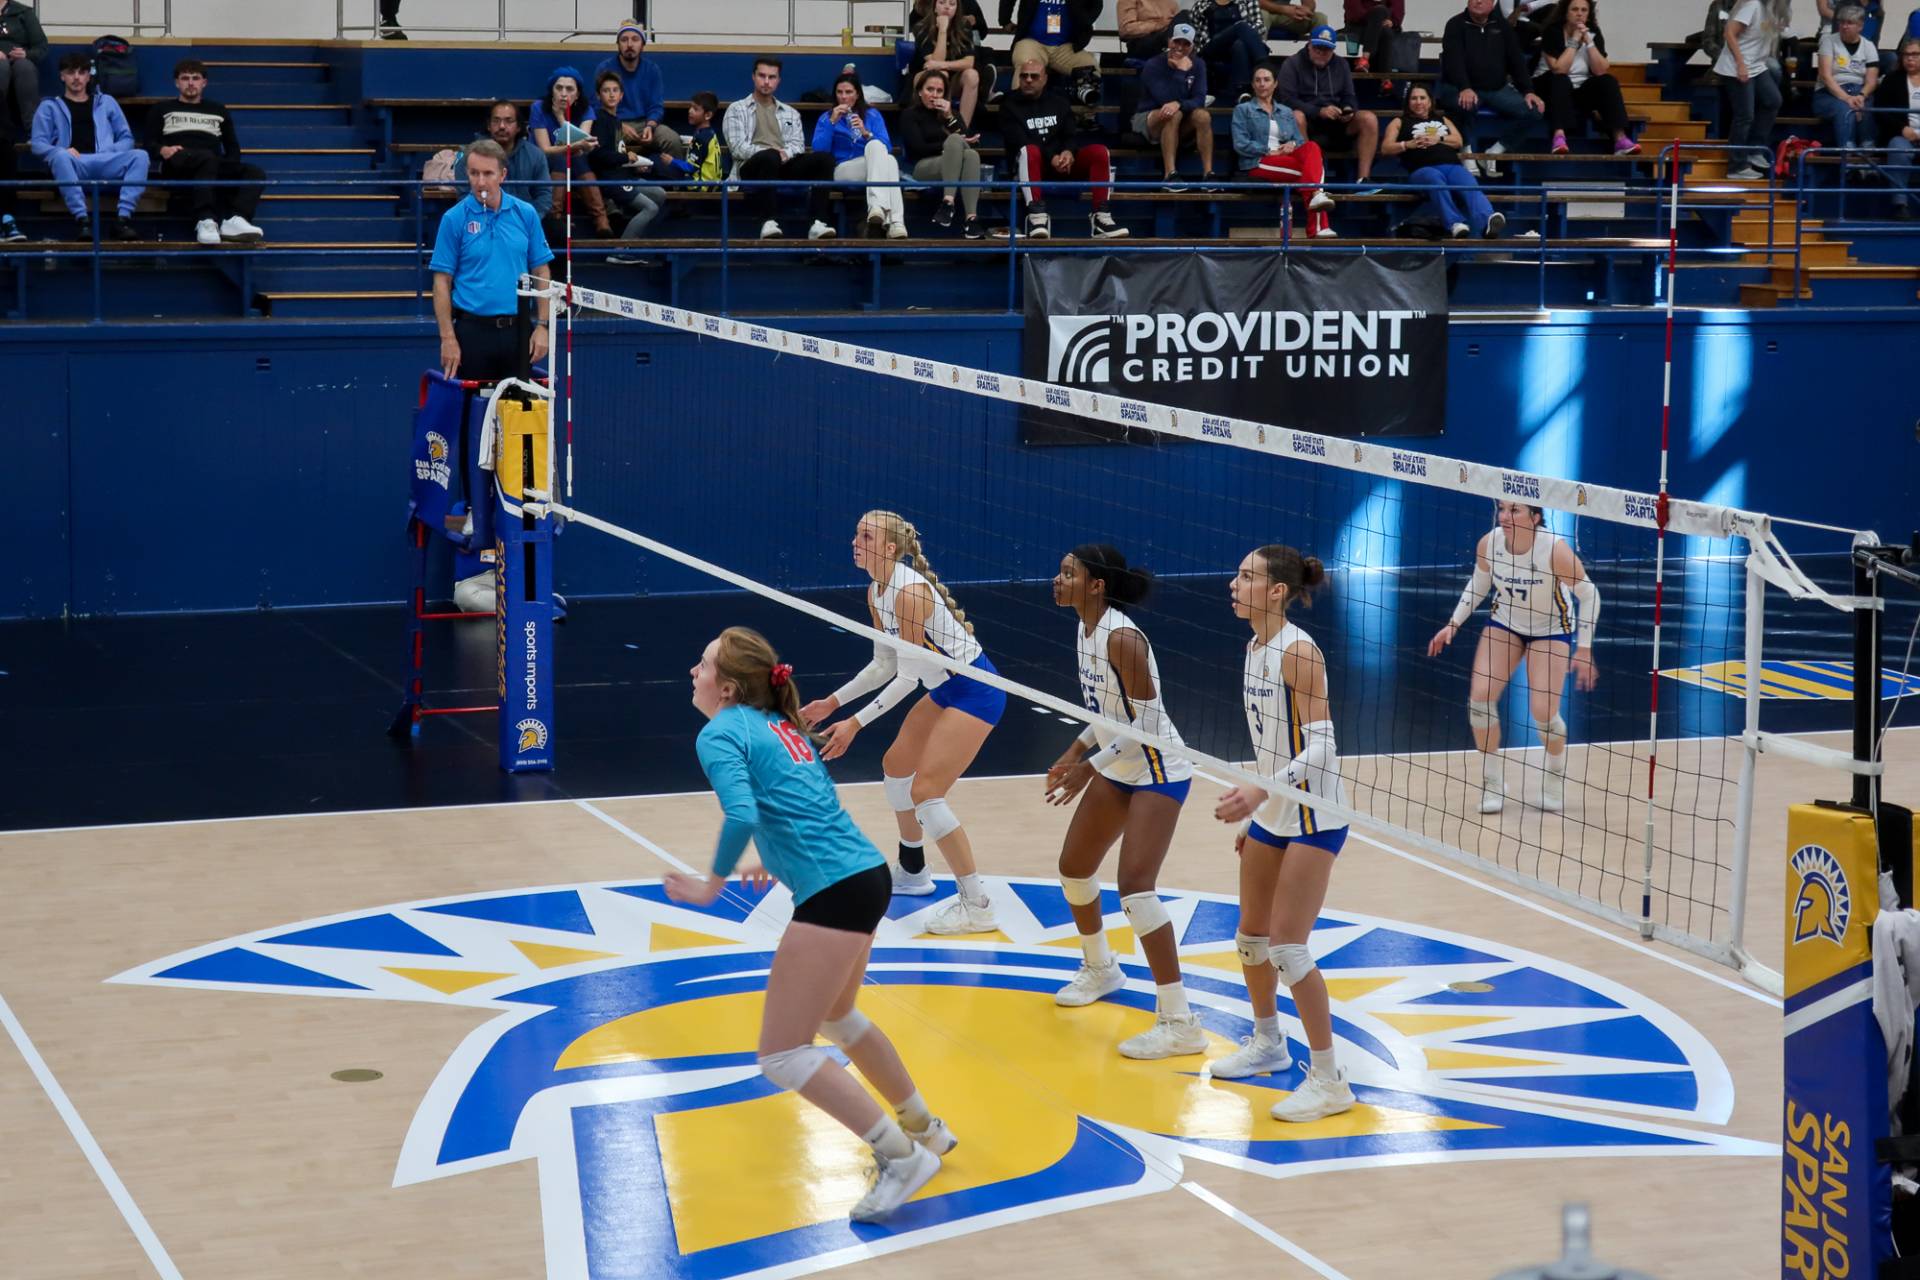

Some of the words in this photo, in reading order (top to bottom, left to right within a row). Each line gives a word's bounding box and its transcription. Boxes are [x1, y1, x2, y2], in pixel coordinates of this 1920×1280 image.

[1126, 311, 1413, 354] PROVIDENT
[1122, 355, 1264, 383] CREDIT
[1286, 354, 1410, 378] UNION
[1120, 408, 1148, 422] SPARTANS
[1202, 424, 1232, 439] SPARTANS
[1292, 441, 1326, 456] SPARTANS
[1393, 460, 1427, 476] SPARTANS
[1503, 481, 1540, 499] SPARTANS
[1625, 494, 1636, 503] SAN
[1625, 504, 1658, 520] SPARTA
[524, 621, 538, 660] sports
[524, 662, 538, 710] imports
[1251, 703, 1264, 735] 3
[768, 720, 815, 764] 16
[1822, 1113, 1850, 1218] SAN
[1822, 1212, 1850, 1280] JO
